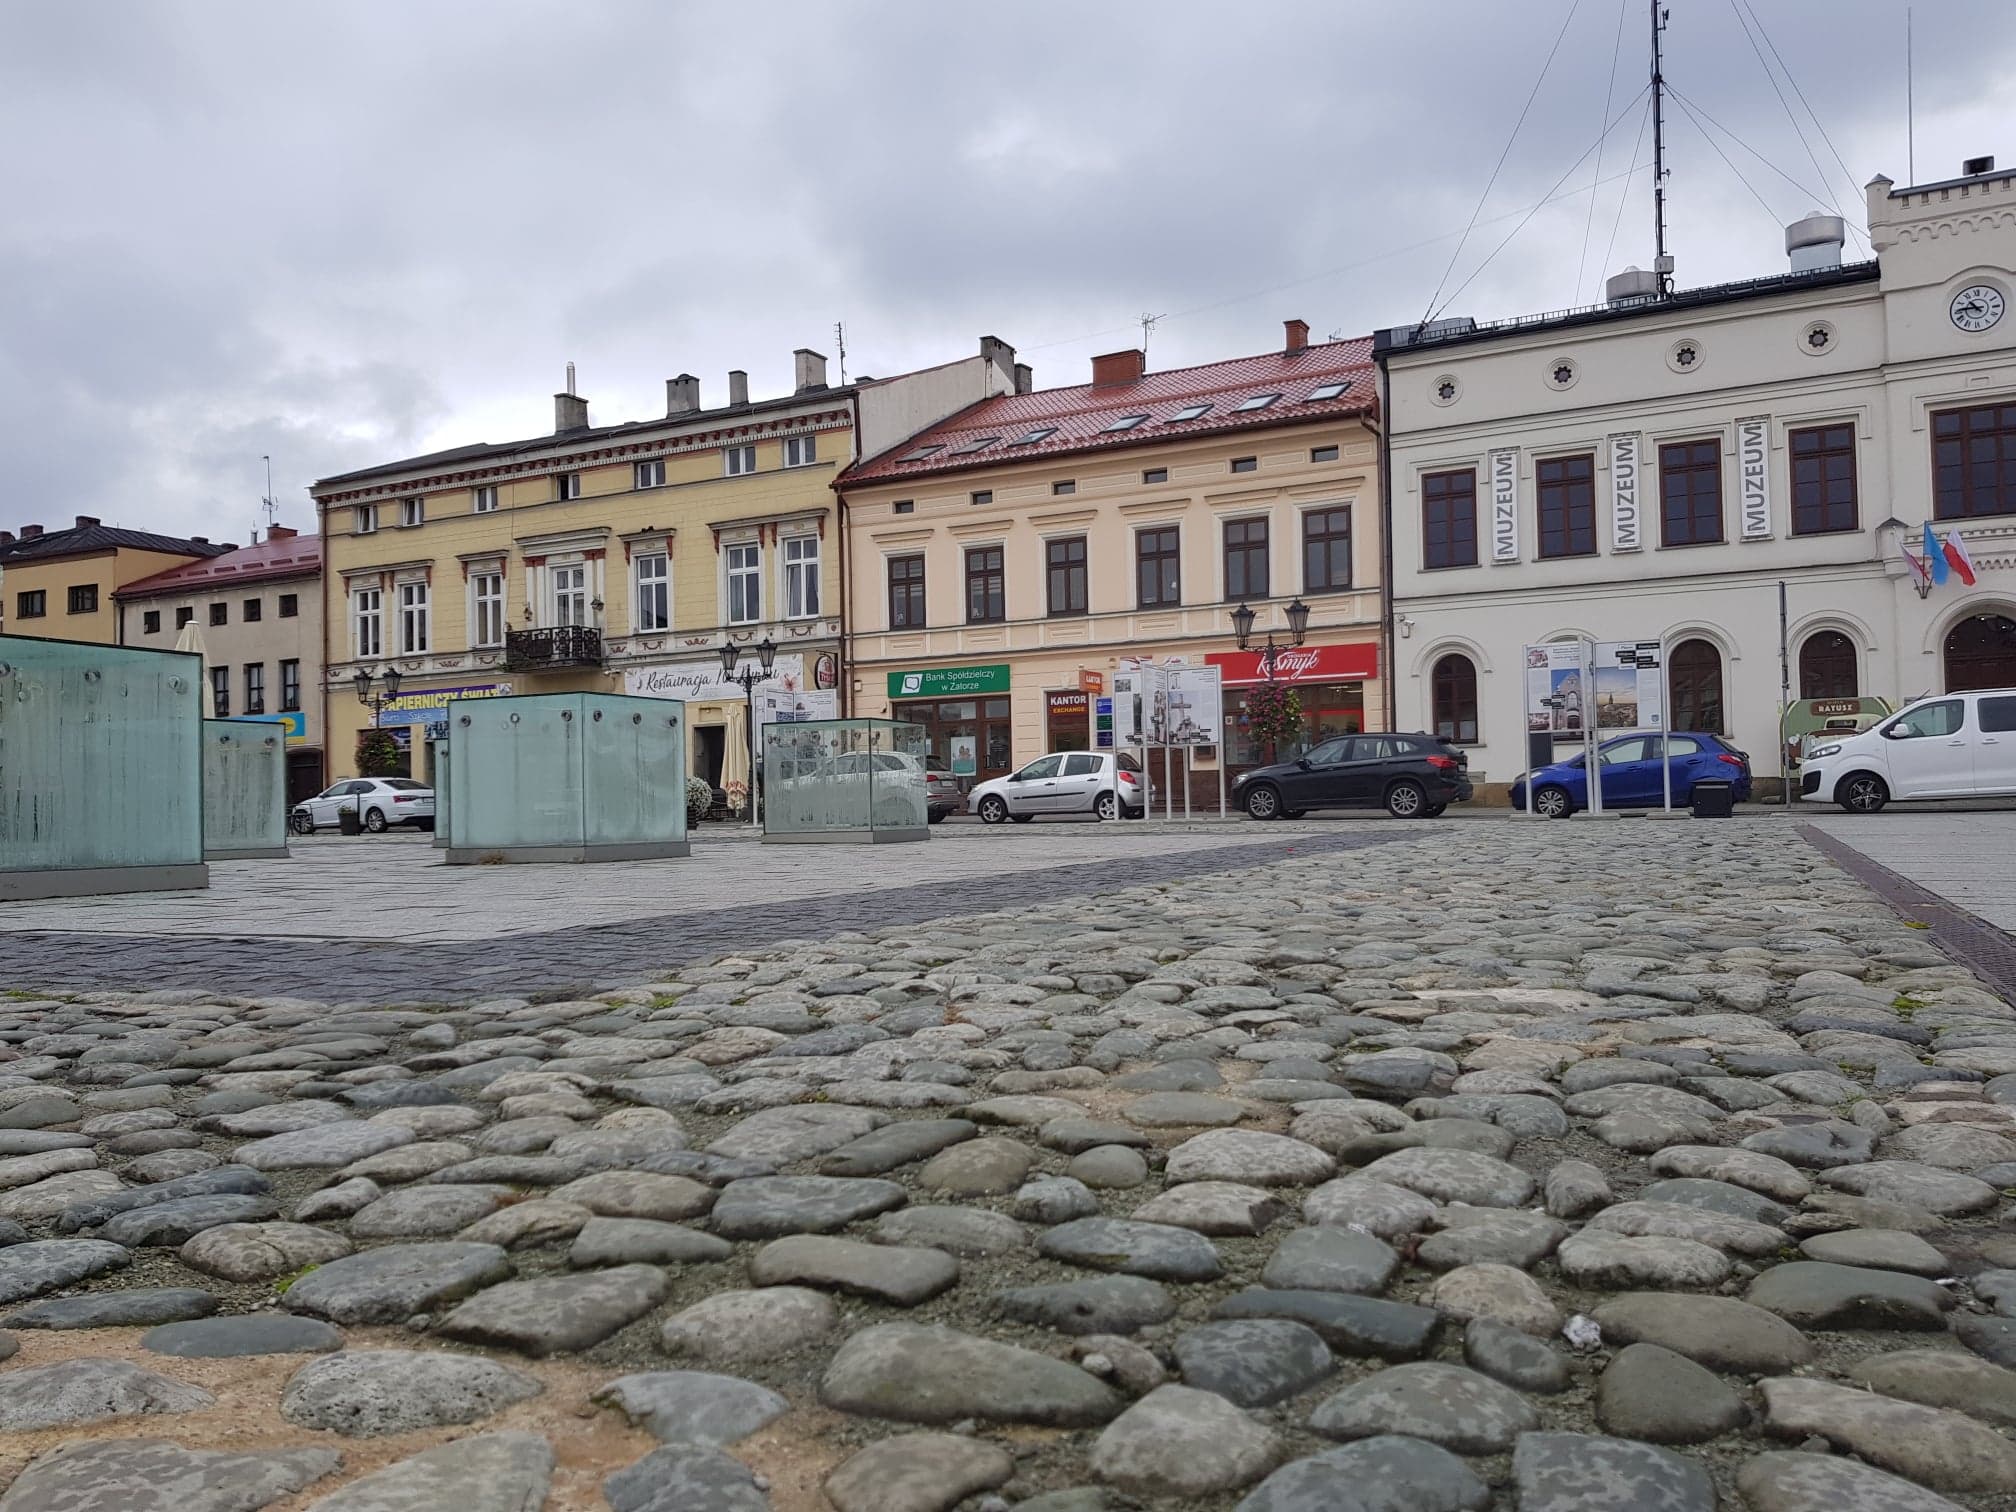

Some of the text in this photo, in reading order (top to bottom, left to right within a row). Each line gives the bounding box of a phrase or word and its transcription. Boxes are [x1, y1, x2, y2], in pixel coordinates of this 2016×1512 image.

[1744, 424, 1766, 532] MUZEUM
[1616, 438, 1636, 545] MUZEUM
[1497, 452, 1514, 556] MUZEUM
[646, 671, 712, 697] Restauracja
[926, 669, 995, 682] Bank Spółdzielczy
[950, 682, 980, 691] Zatorze
[1050, 695, 1087, 706] KANTOR
[1053, 706, 1085, 714] EXCHANGE
